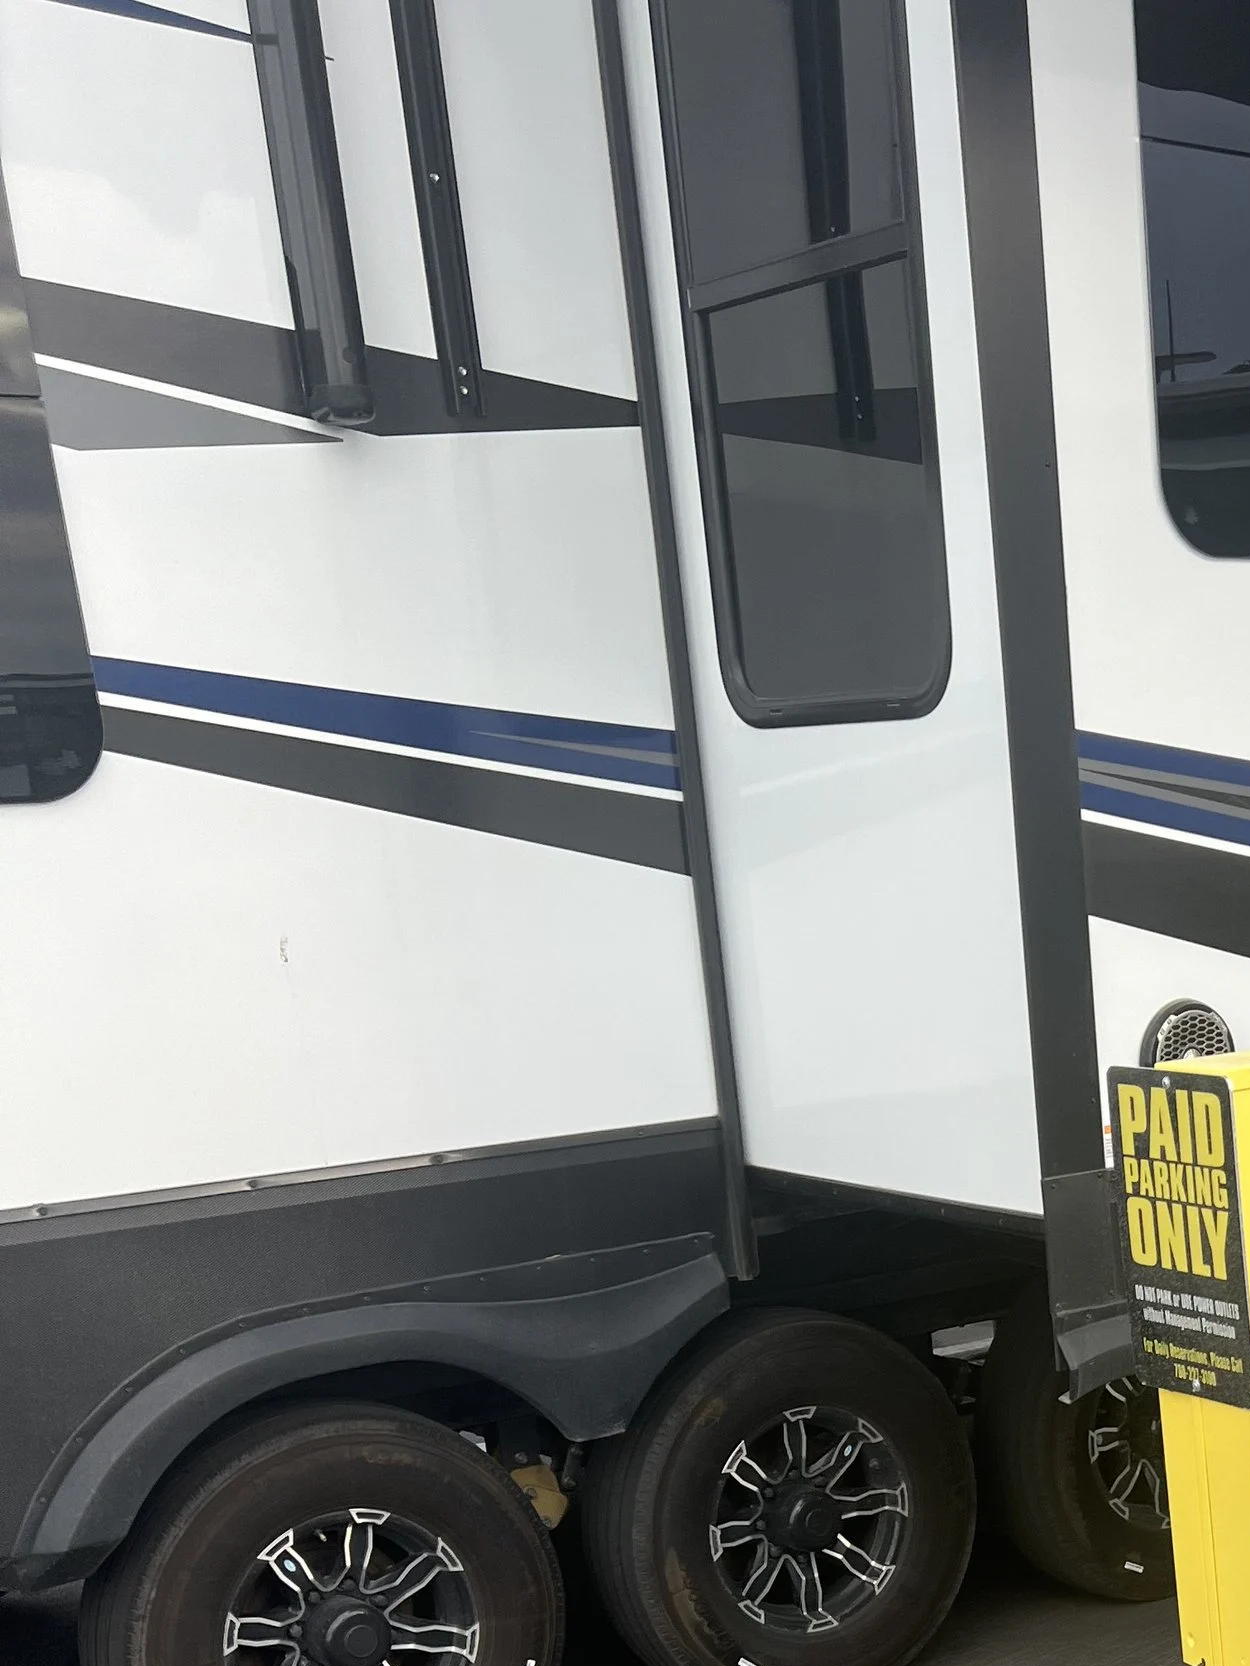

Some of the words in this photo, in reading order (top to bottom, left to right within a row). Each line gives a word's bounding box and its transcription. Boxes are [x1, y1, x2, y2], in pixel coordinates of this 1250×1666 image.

[1117, 1083, 1226, 1168] PAID
[1123, 1155, 1229, 1209] PARKING
[1126, 1195, 1229, 1281] ONLY
[1134, 1284, 1144, 1301] DO
[1144, 1286, 1156, 1303] NOT
[1156, 1288, 1172, 1306] PARK
[1172, 1294, 1180, 1307] or
[1180, 1293, 1193, 1310] USE
[1193, 1295, 1215, 1315] POWER
[1214, 1300, 1240, 1320] OUTLETS
[1143, 1306, 1165, 1324] without
[1164, 1309, 1202, 1331] Management
[1201, 1317, 1237, 1340] Permission
[1143, 1336, 1154, 1354] For
[1209, 1351, 1231, 1372] Please
[1230, 1356, 1244, 1374] Call
